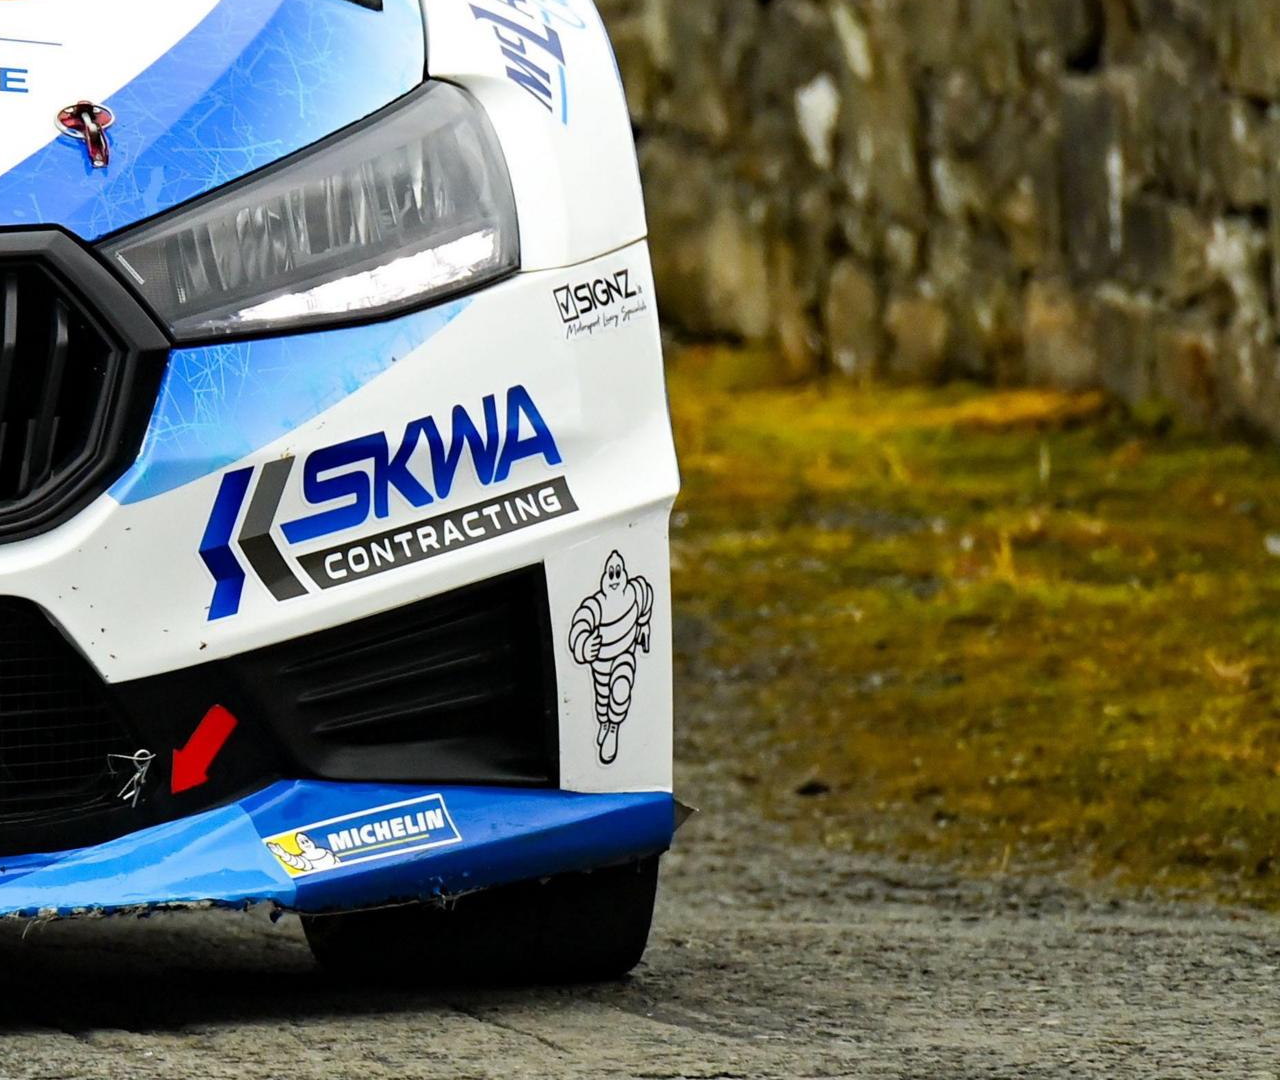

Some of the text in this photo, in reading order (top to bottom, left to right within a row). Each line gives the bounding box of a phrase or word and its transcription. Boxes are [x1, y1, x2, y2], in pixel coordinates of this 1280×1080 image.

[280, 383, 563, 545] SKWA
[323, 485, 562, 580] CONTRACTING
[327, 807, 446, 852] MICHELIN
